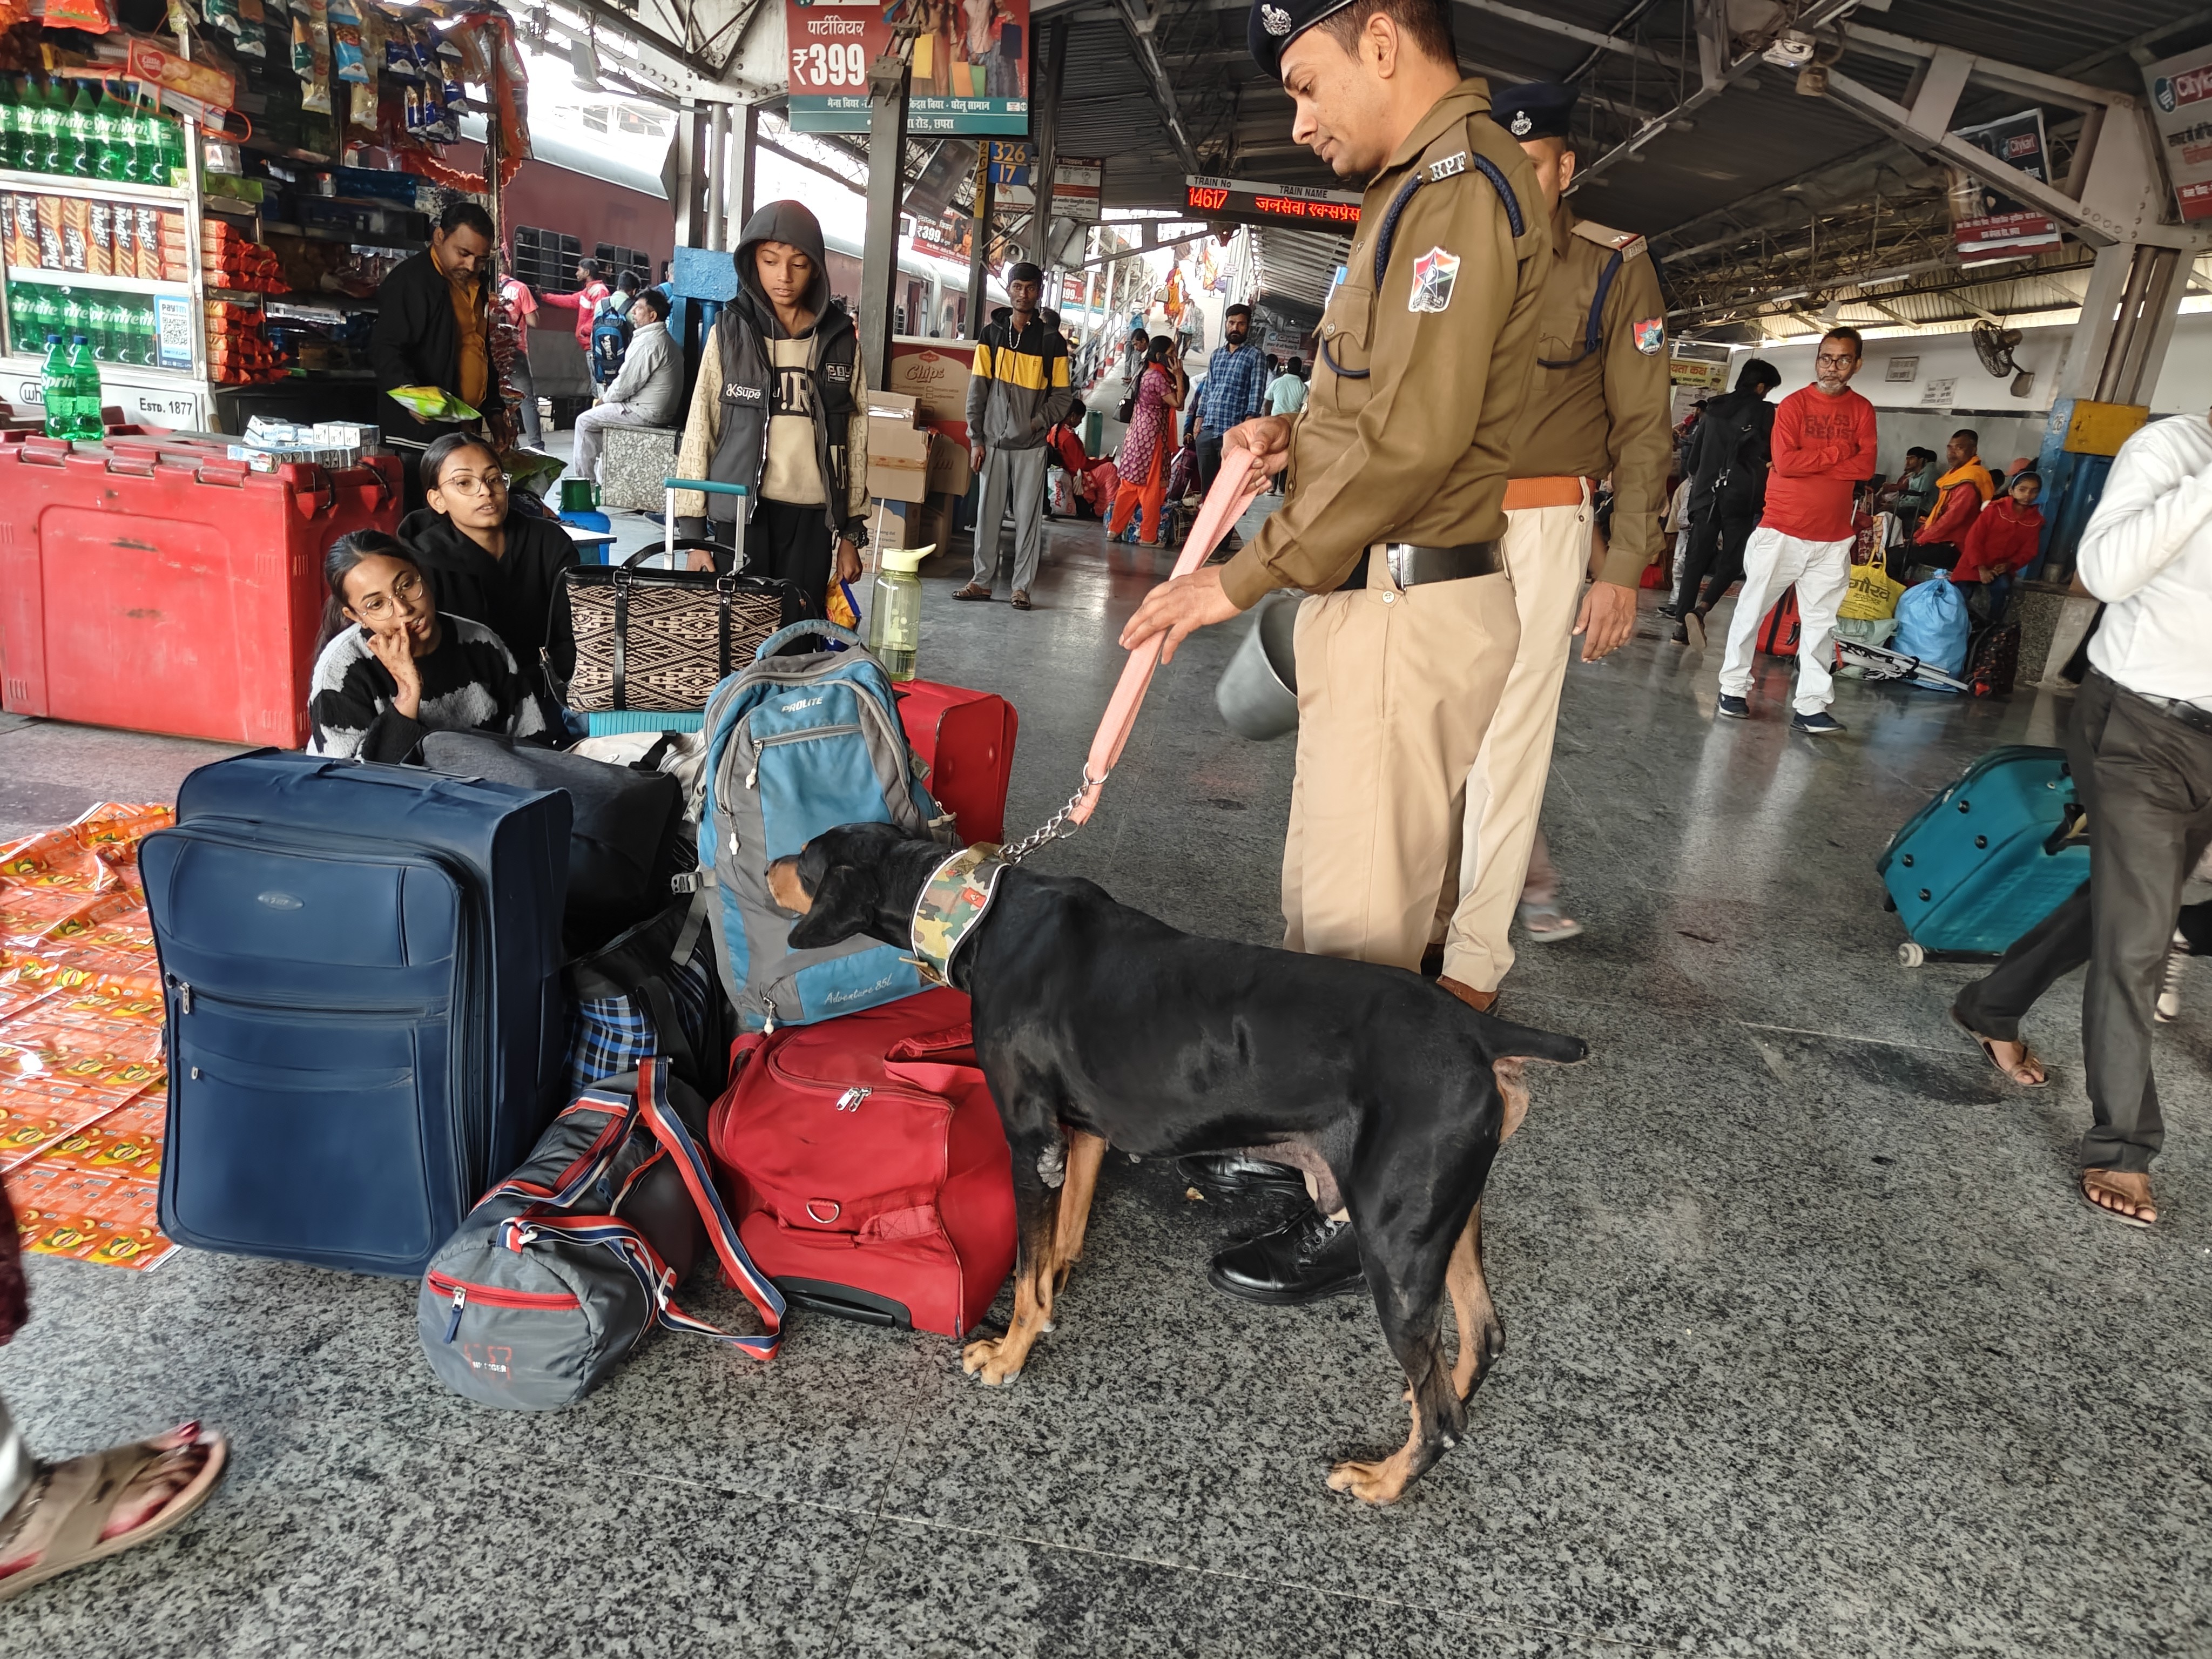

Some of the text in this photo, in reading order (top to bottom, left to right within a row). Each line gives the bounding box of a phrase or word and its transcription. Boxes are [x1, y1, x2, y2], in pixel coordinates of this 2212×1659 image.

[807, 15, 865, 36] पार्टीवियर
[792, 43, 865, 86] ₹399
[843, 97, 860, 108] वियर
[928, 98, 944, 109] वियर
[951, 99, 990, 113] घरेलू सामान
[934, 119, 955, 129] छपरा
[993, 141, 1026, 162] 326
[999, 164, 1016, 183] 17
[1429, 151, 1467, 182] RPF
[1194, 177, 1231, 188] TRAIN No
[1279, 185, 1328, 198] TRAIN NAME
[1189, 187, 1228, 208] 14617
[1256, 197, 1305, 214] जनसेवा
[15, 196, 35, 238] Magic
[90, 205, 110, 248] Magic
[113, 206, 131, 248] Magic
[135, 208, 156, 251] Magic
[917, 225, 941, 243] ₹399
[41, 227, 63, 269] Magic
[66, 228, 86, 270] Magic
[906, 365, 945, 383] Chips
[169, 401, 192, 415] 1877
[1849, 577, 1890, 602] गौरव
[781, 696, 824, 712] PROLITE
[824, 989, 874, 1005] Adventure
